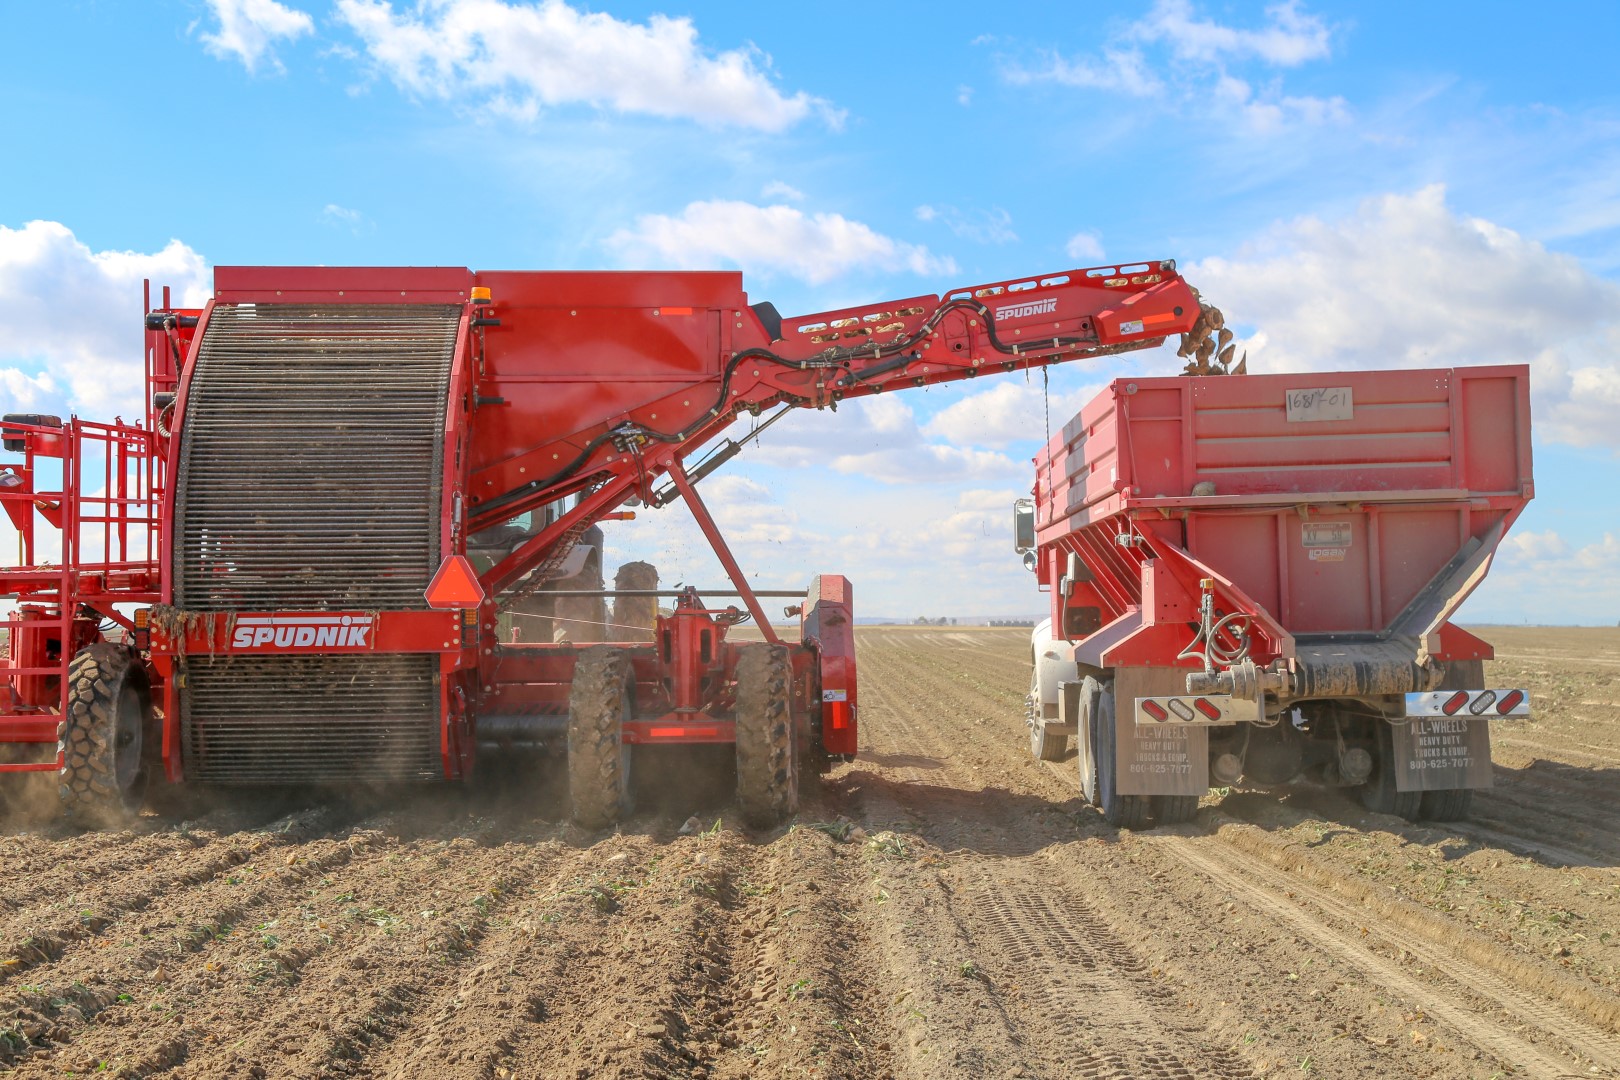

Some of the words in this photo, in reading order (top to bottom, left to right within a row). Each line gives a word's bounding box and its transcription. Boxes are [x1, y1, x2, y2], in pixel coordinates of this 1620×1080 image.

[996, 299, 1057, 321] SPUDNIK
[232, 615, 371, 648] SPUDNIK
[1133, 726, 1188, 739] ALL-WHEELS
[1411, 720, 1468, 735] ALL-WHEELS
[1140, 741, 1161, 750] HEAVY
[1163, 741, 1181, 750] DUTY
[1419, 736, 1441, 746] HEAVY
[1442, 735, 1460, 745] DUTY
[1136, 753, 1160, 762] TRUCKS
[1162, 753, 1167, 762] &
[1168, 753, 1189, 762] EQUIP.
[1414, 748, 1440, 758] TRUCKS
[1442, 747, 1447, 756] &
[1130, 764, 1192, 774] 800-625-7077
[1410, 757, 1475, 770] 800-625-7077
